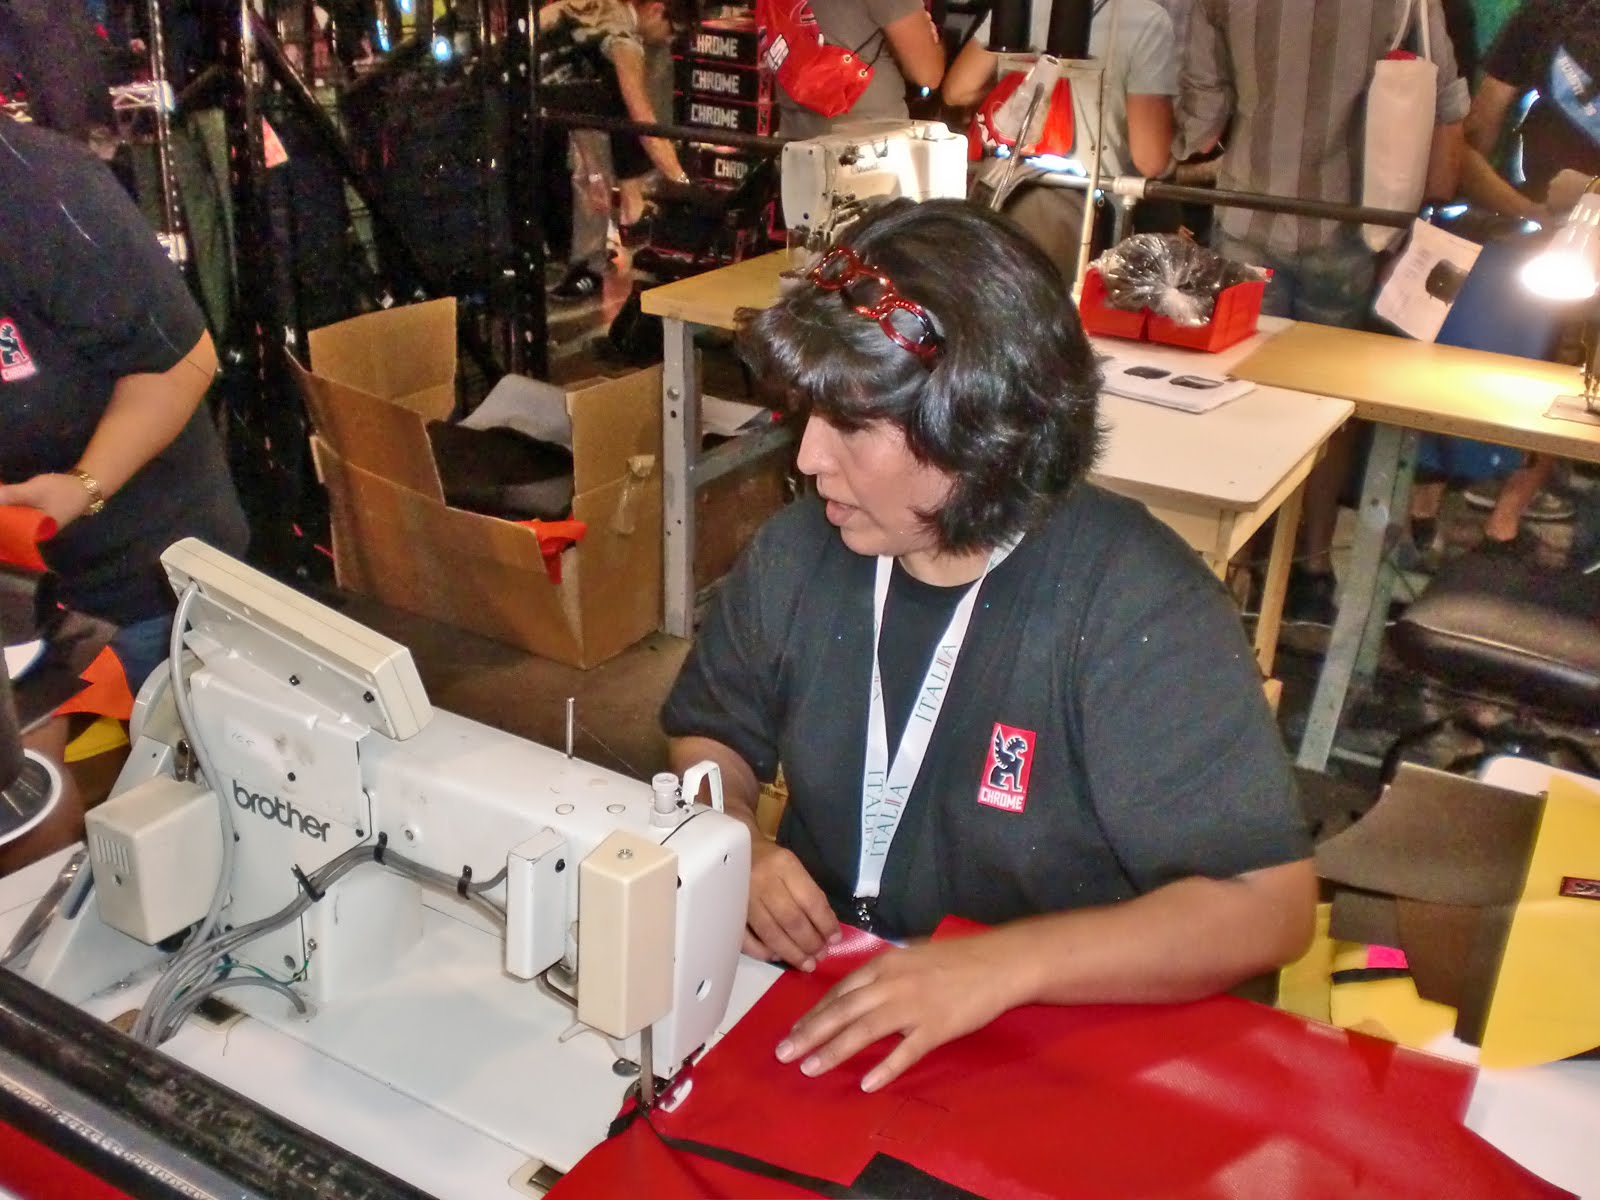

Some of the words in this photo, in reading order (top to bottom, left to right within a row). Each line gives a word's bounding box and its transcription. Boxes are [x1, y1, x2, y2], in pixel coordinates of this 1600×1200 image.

[692, 69, 740, 94] CHROME
[691, 103, 739, 129] CHROME
[232, 779, 331, 842] brother
[981, 787, 1024, 810] CHROME
